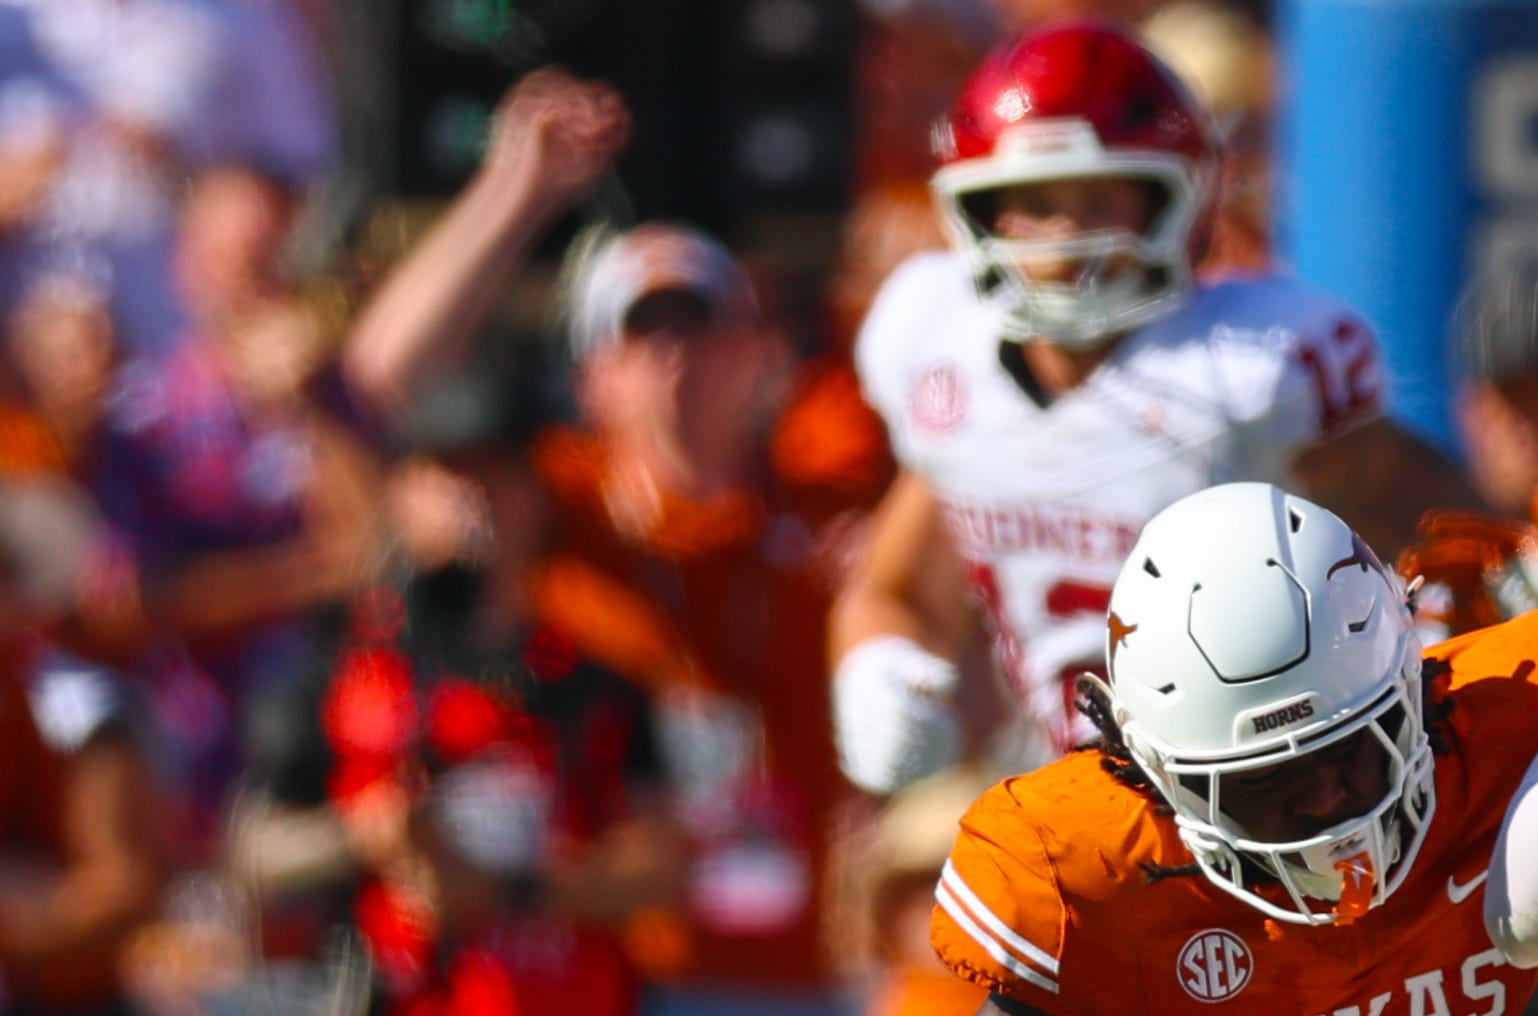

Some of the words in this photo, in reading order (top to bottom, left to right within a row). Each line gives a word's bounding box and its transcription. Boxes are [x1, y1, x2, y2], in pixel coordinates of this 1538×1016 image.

[1297, 312, 1383, 430] 12
[1251, 698, 1315, 734] HORNS
[1182, 934, 1249, 1001] SEC
